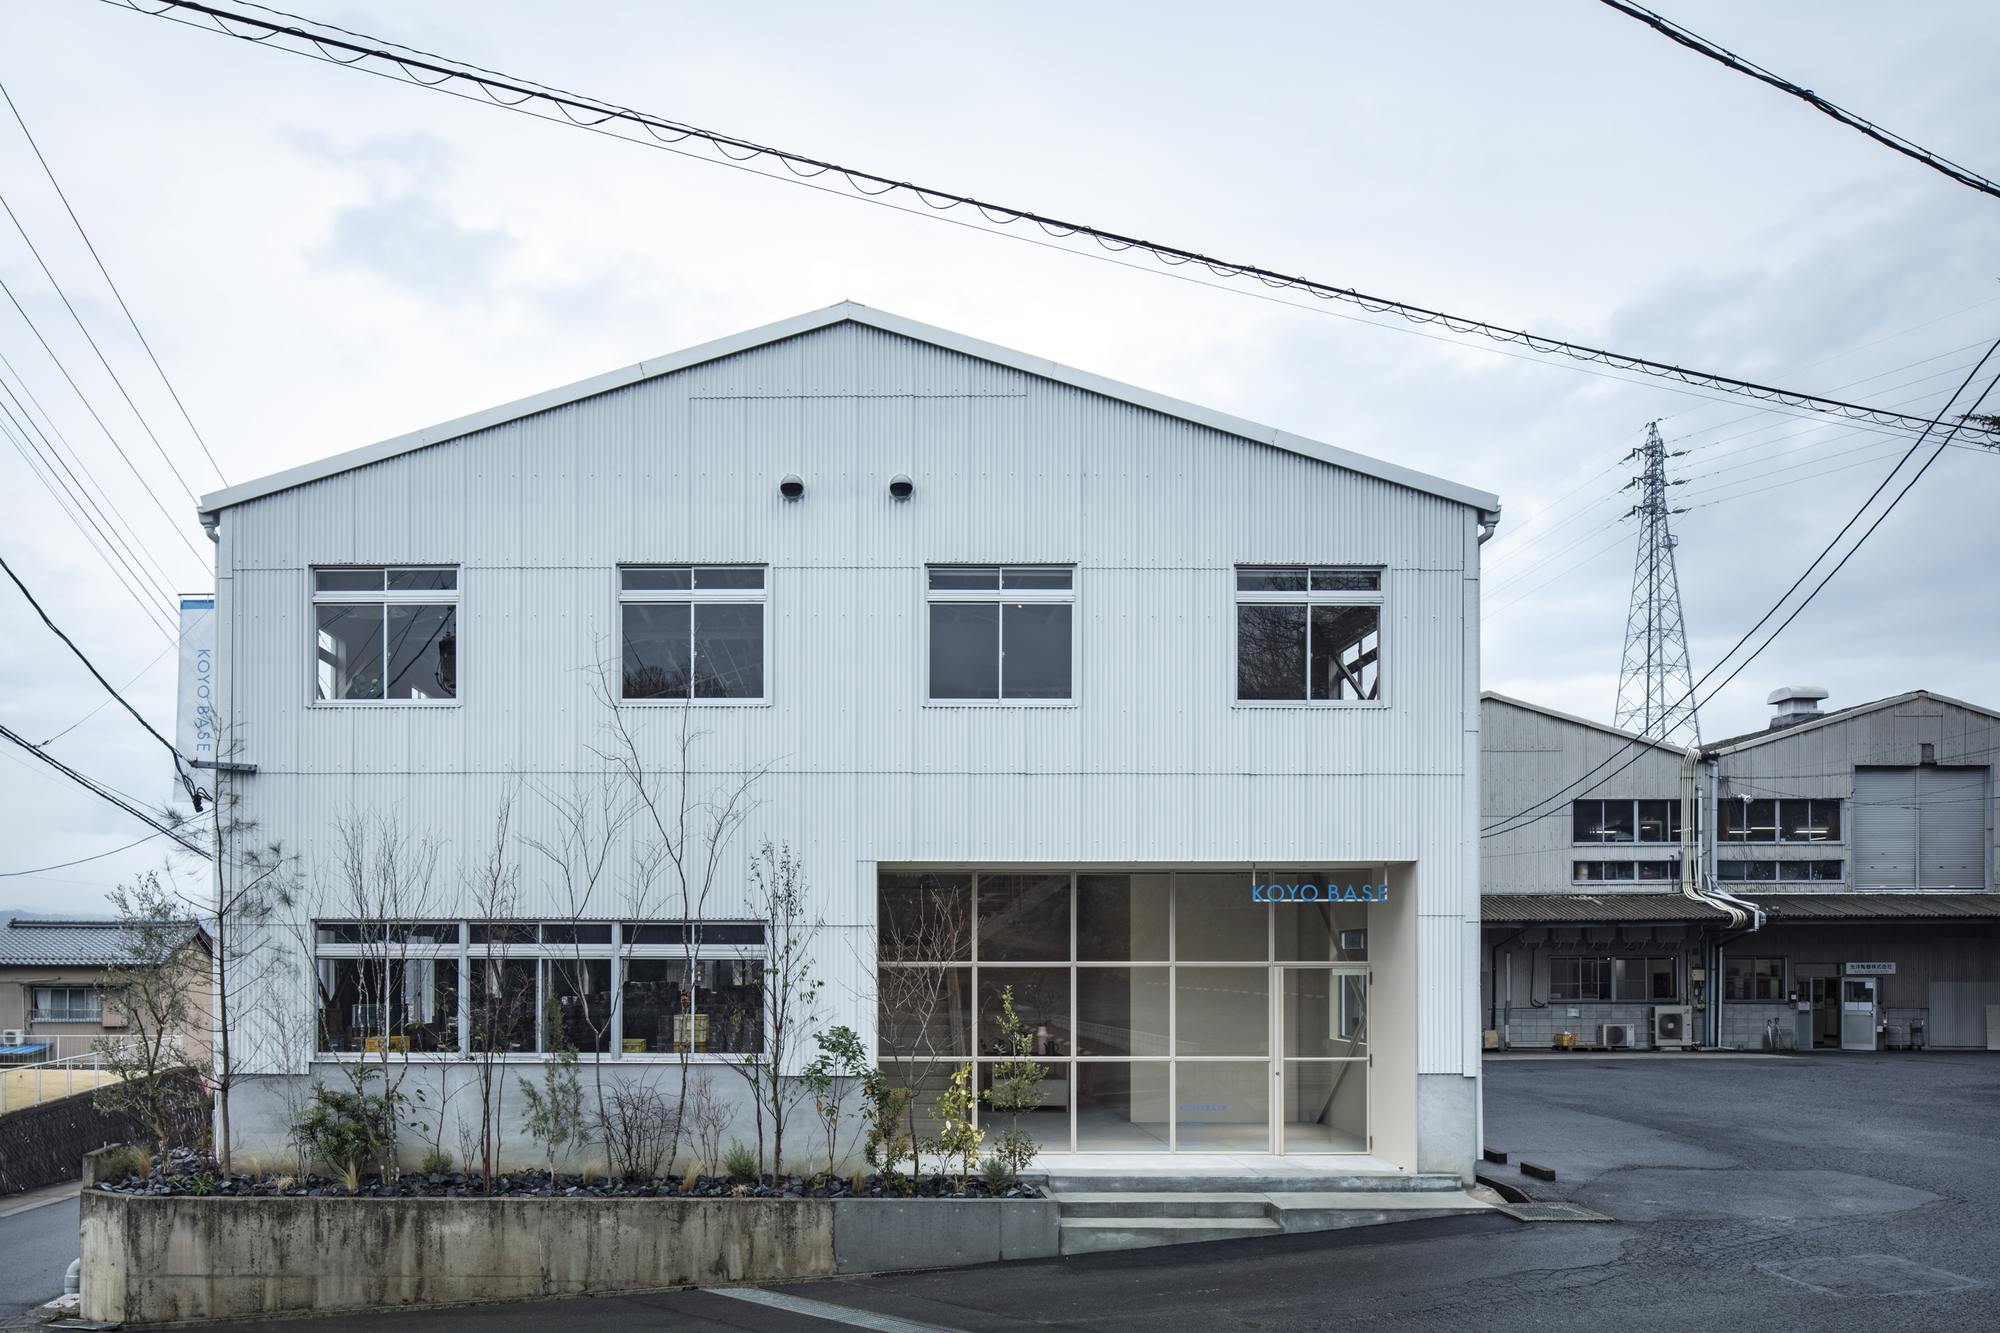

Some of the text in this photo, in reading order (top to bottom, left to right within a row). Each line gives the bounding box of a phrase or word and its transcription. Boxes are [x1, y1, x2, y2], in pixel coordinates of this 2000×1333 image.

[196, 649, 211, 751] KOYO BASE
[1252, 884, 1318, 902] KOYO
[1328, 884, 1388, 902] BASE
[1179, 1104, 1228, 1112] KOYO BASE
